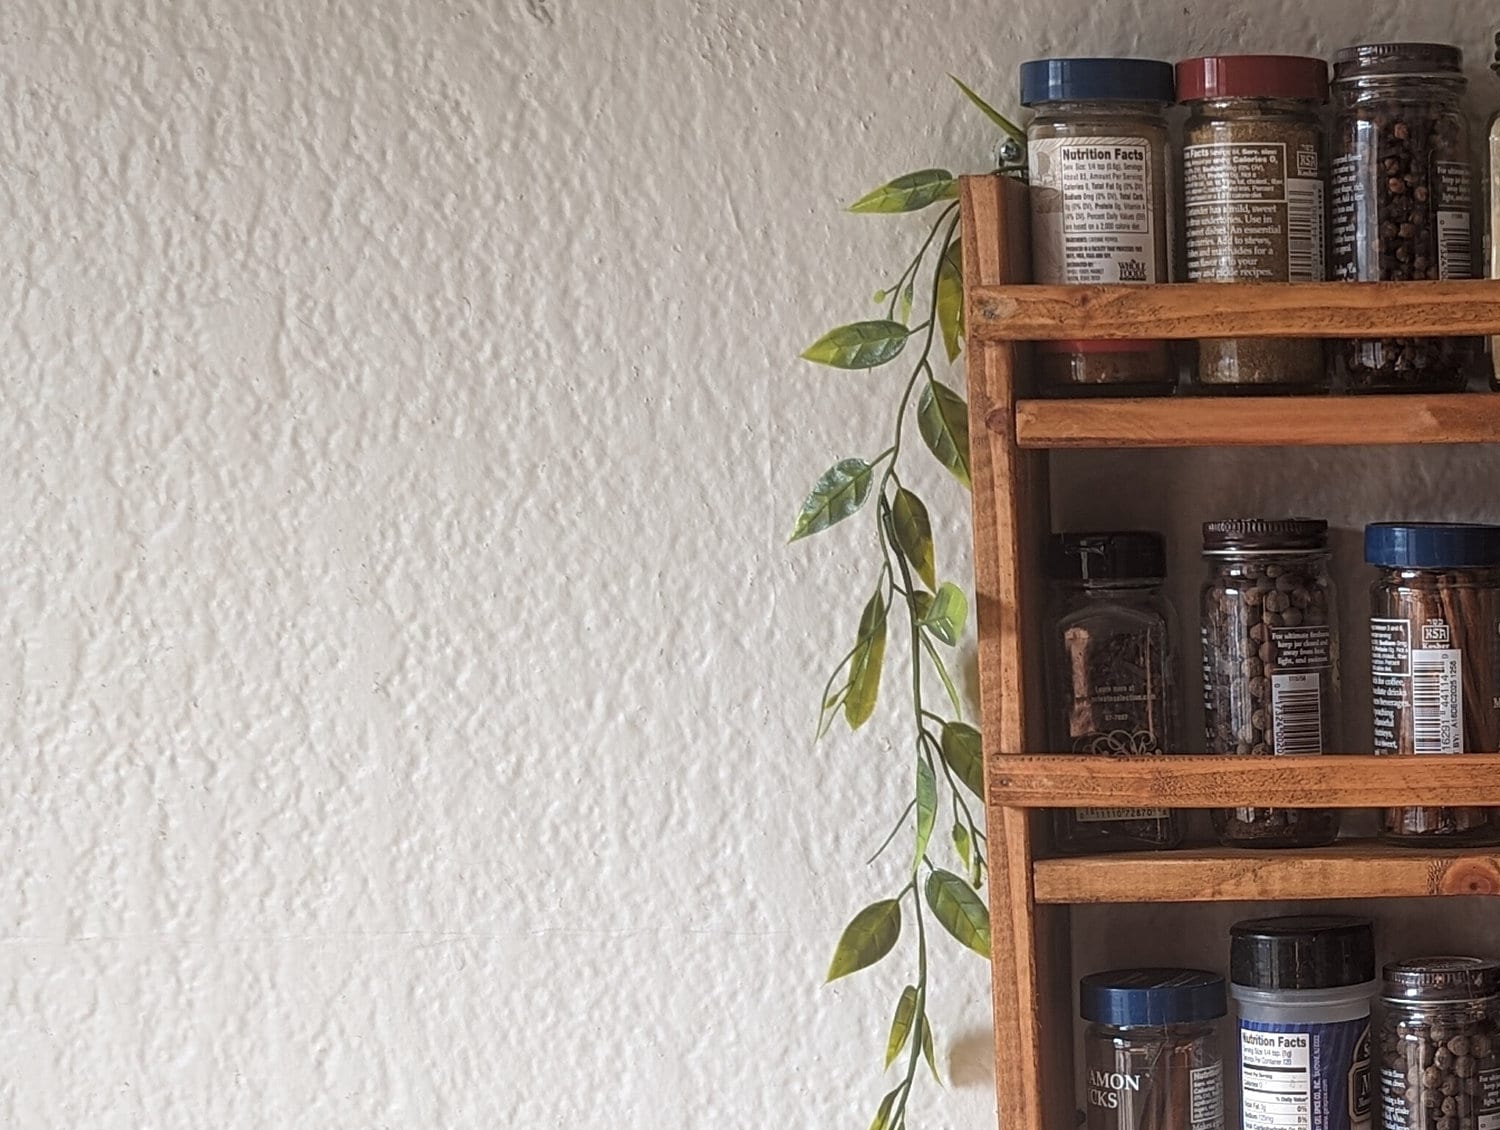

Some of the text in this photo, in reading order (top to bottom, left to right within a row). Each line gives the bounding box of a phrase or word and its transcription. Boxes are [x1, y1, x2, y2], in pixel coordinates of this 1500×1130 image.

[1063, 148, 1144, 161] Nutrition Facts
[1233, 156, 1268, 164] Calories
[1252, 205, 1278, 213] sweet
[1245, 215, 1273, 223] Use in
[1244, 225, 1281, 234] essential
[1254, 247, 1268, 255] for
[1238, 259, 1258, 269] your
[1240, 269, 1274, 279] recipes.
[1441, 674, 1450, 708] 44114
[1278, 1036, 1307, 1048] Facts
[1297, 1105, 1308, 1113] 0%
[1314, 1100, 1323, 1125] GEL SPICE
